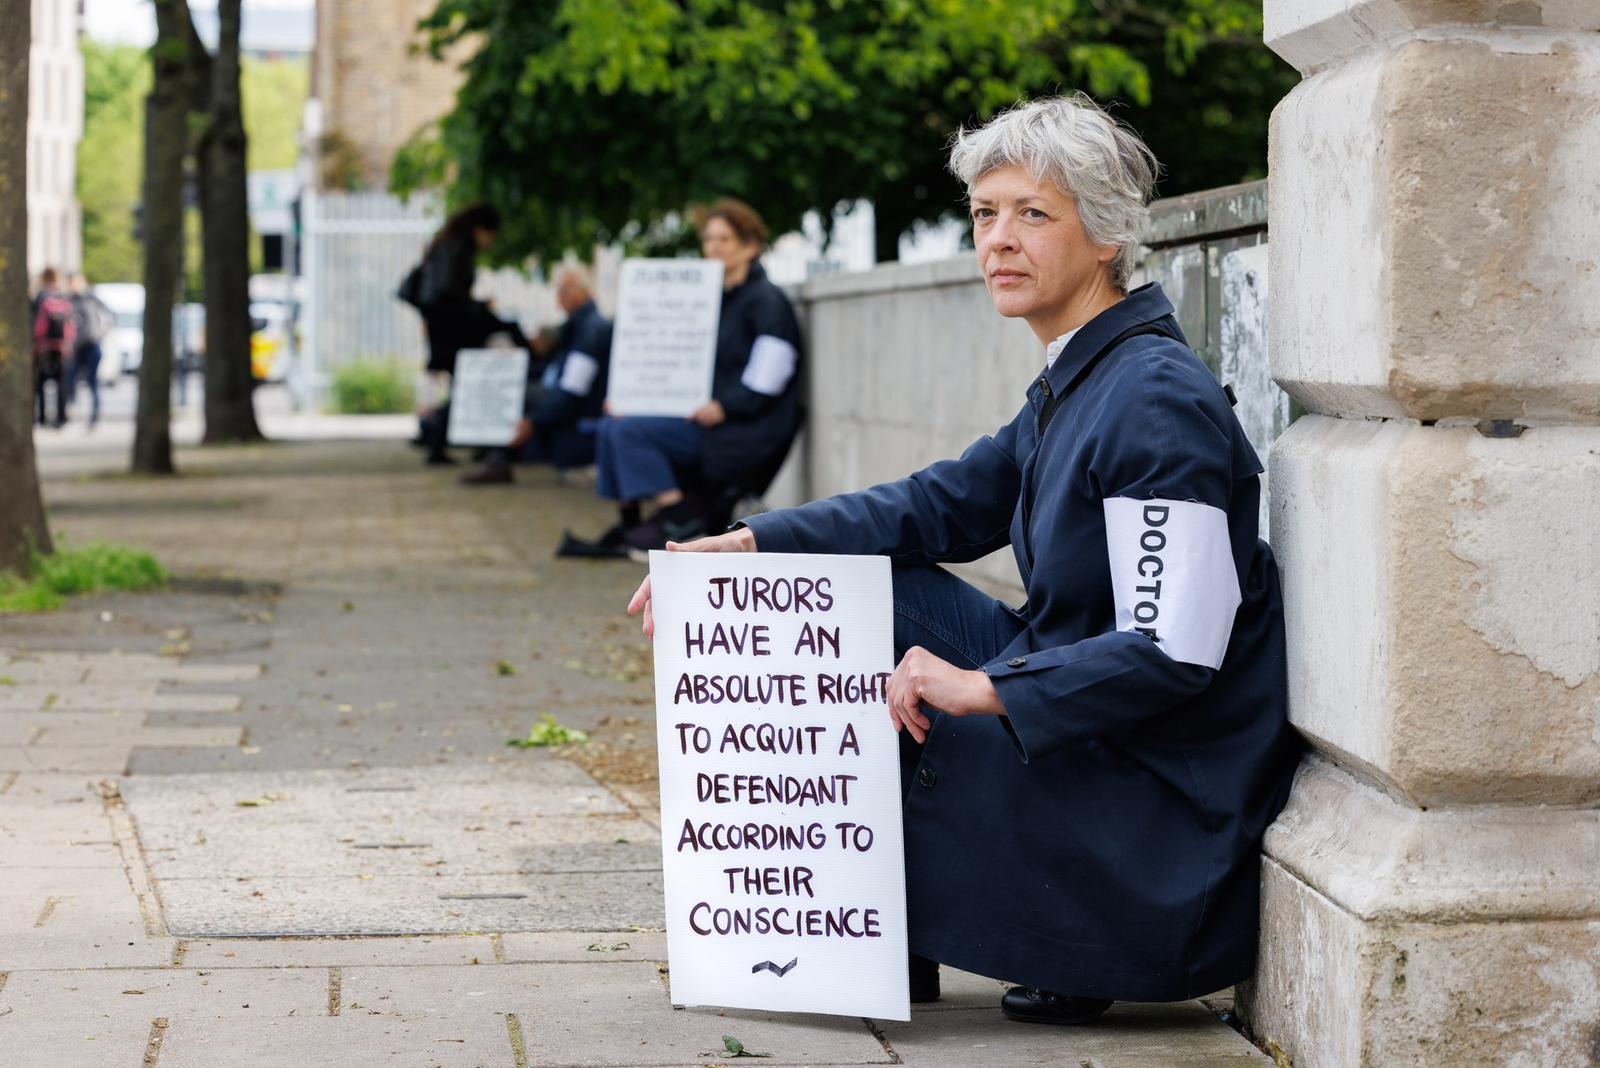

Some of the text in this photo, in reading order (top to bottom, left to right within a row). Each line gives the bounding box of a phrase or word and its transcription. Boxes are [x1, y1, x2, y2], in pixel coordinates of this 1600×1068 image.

[707, 576, 834, 613] JURORS
[685, 621, 841, 659] HAVE AN
[673, 671, 892, 707] ABSOLUTE RIGHT
[674, 722, 860, 757] TO ACQUIT A
[696, 772, 858, 808] DEFENDANT
[677, 818, 874, 853] ACCORDING TO
[723, 865, 814, 899] THEIR
[689, 901, 882, 938] CONSCIENCE
